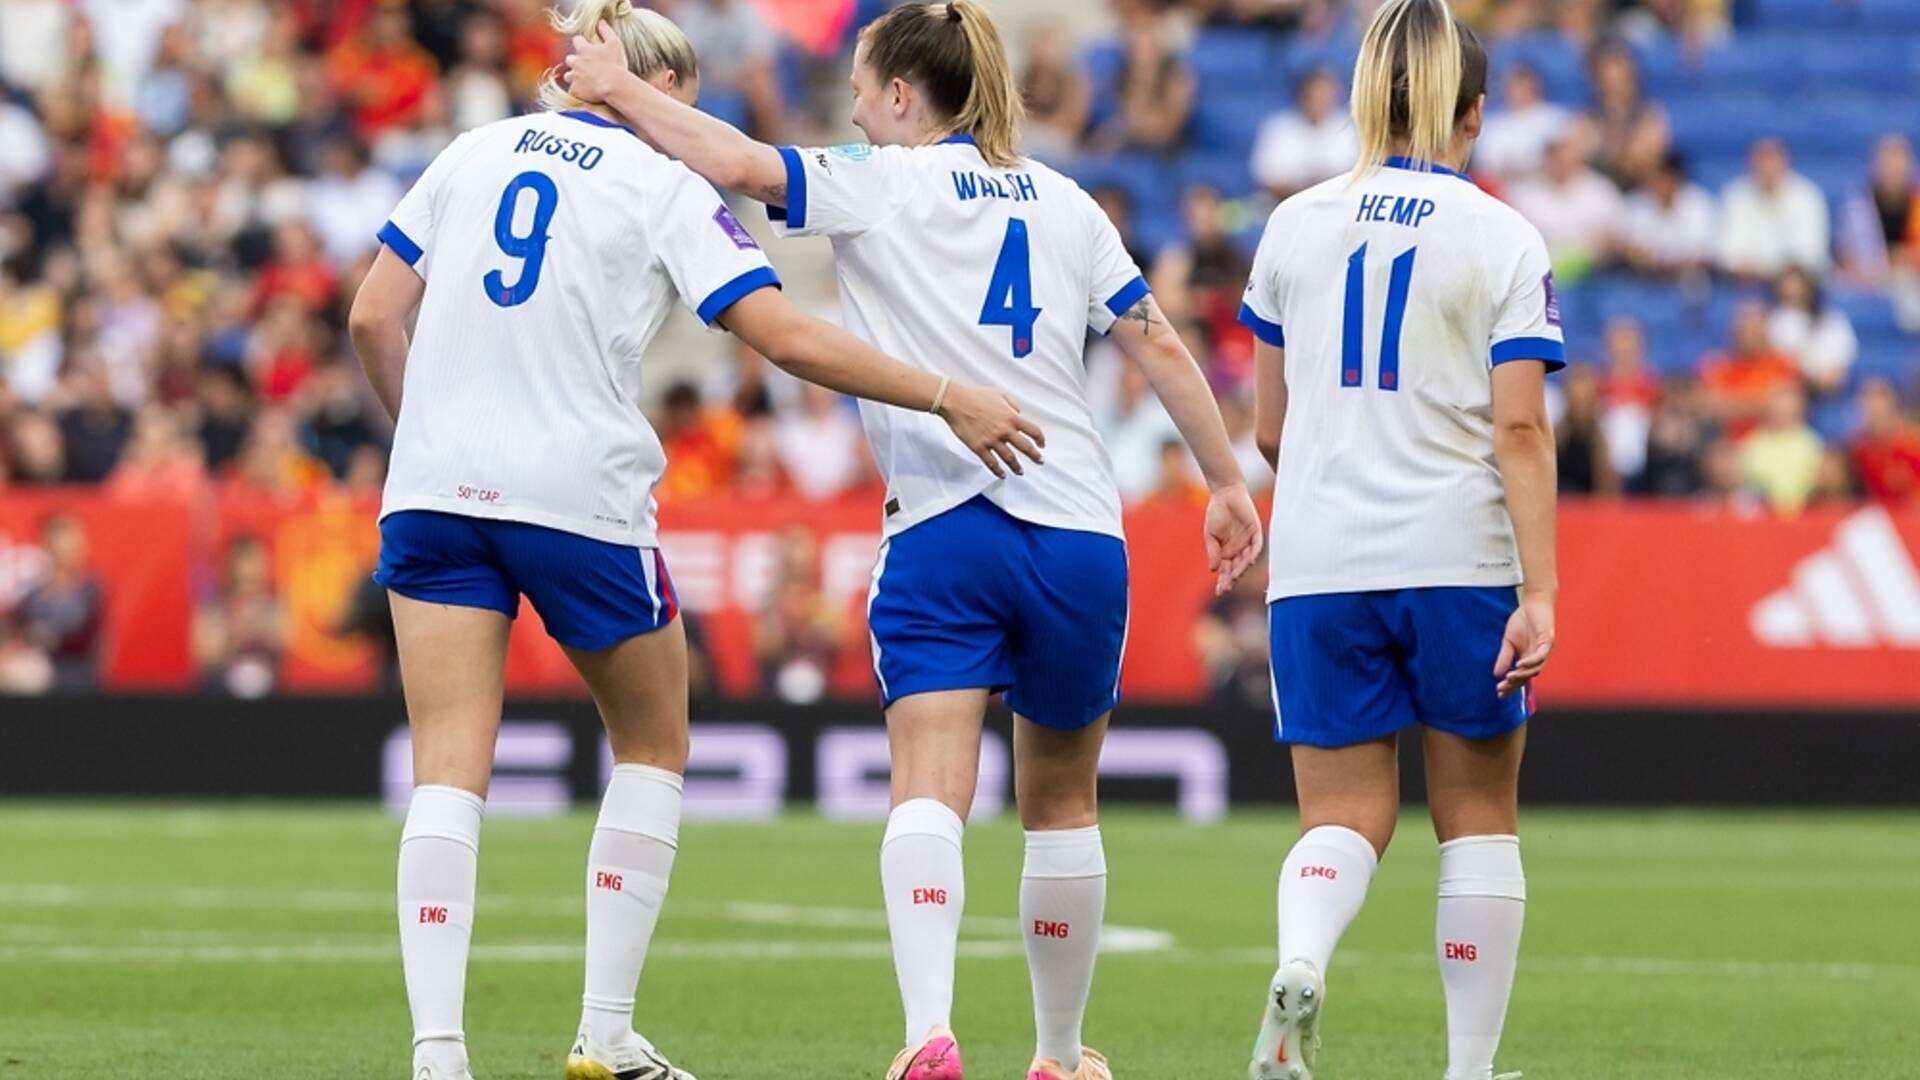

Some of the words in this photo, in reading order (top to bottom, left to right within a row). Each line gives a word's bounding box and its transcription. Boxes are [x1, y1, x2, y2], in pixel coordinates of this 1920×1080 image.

[513, 128, 604, 170] RUSSO
[951, 170, 1038, 202] WALSH
[1355, 194, 1435, 228] HEMP
[483, 170, 559, 308] 9
[978, 216, 1043, 359] 4
[1341, 240, 1418, 392] 11
[478, 489, 500, 502] CAP
[596, 872, 623, 891] ENG
[1301, 866, 1337, 880] ENG
[912, 887, 946, 906] ENG
[419, 906, 447, 925] ENG
[1034, 920, 1068, 939] ENG
[1445, 943, 1477, 961] ENG
